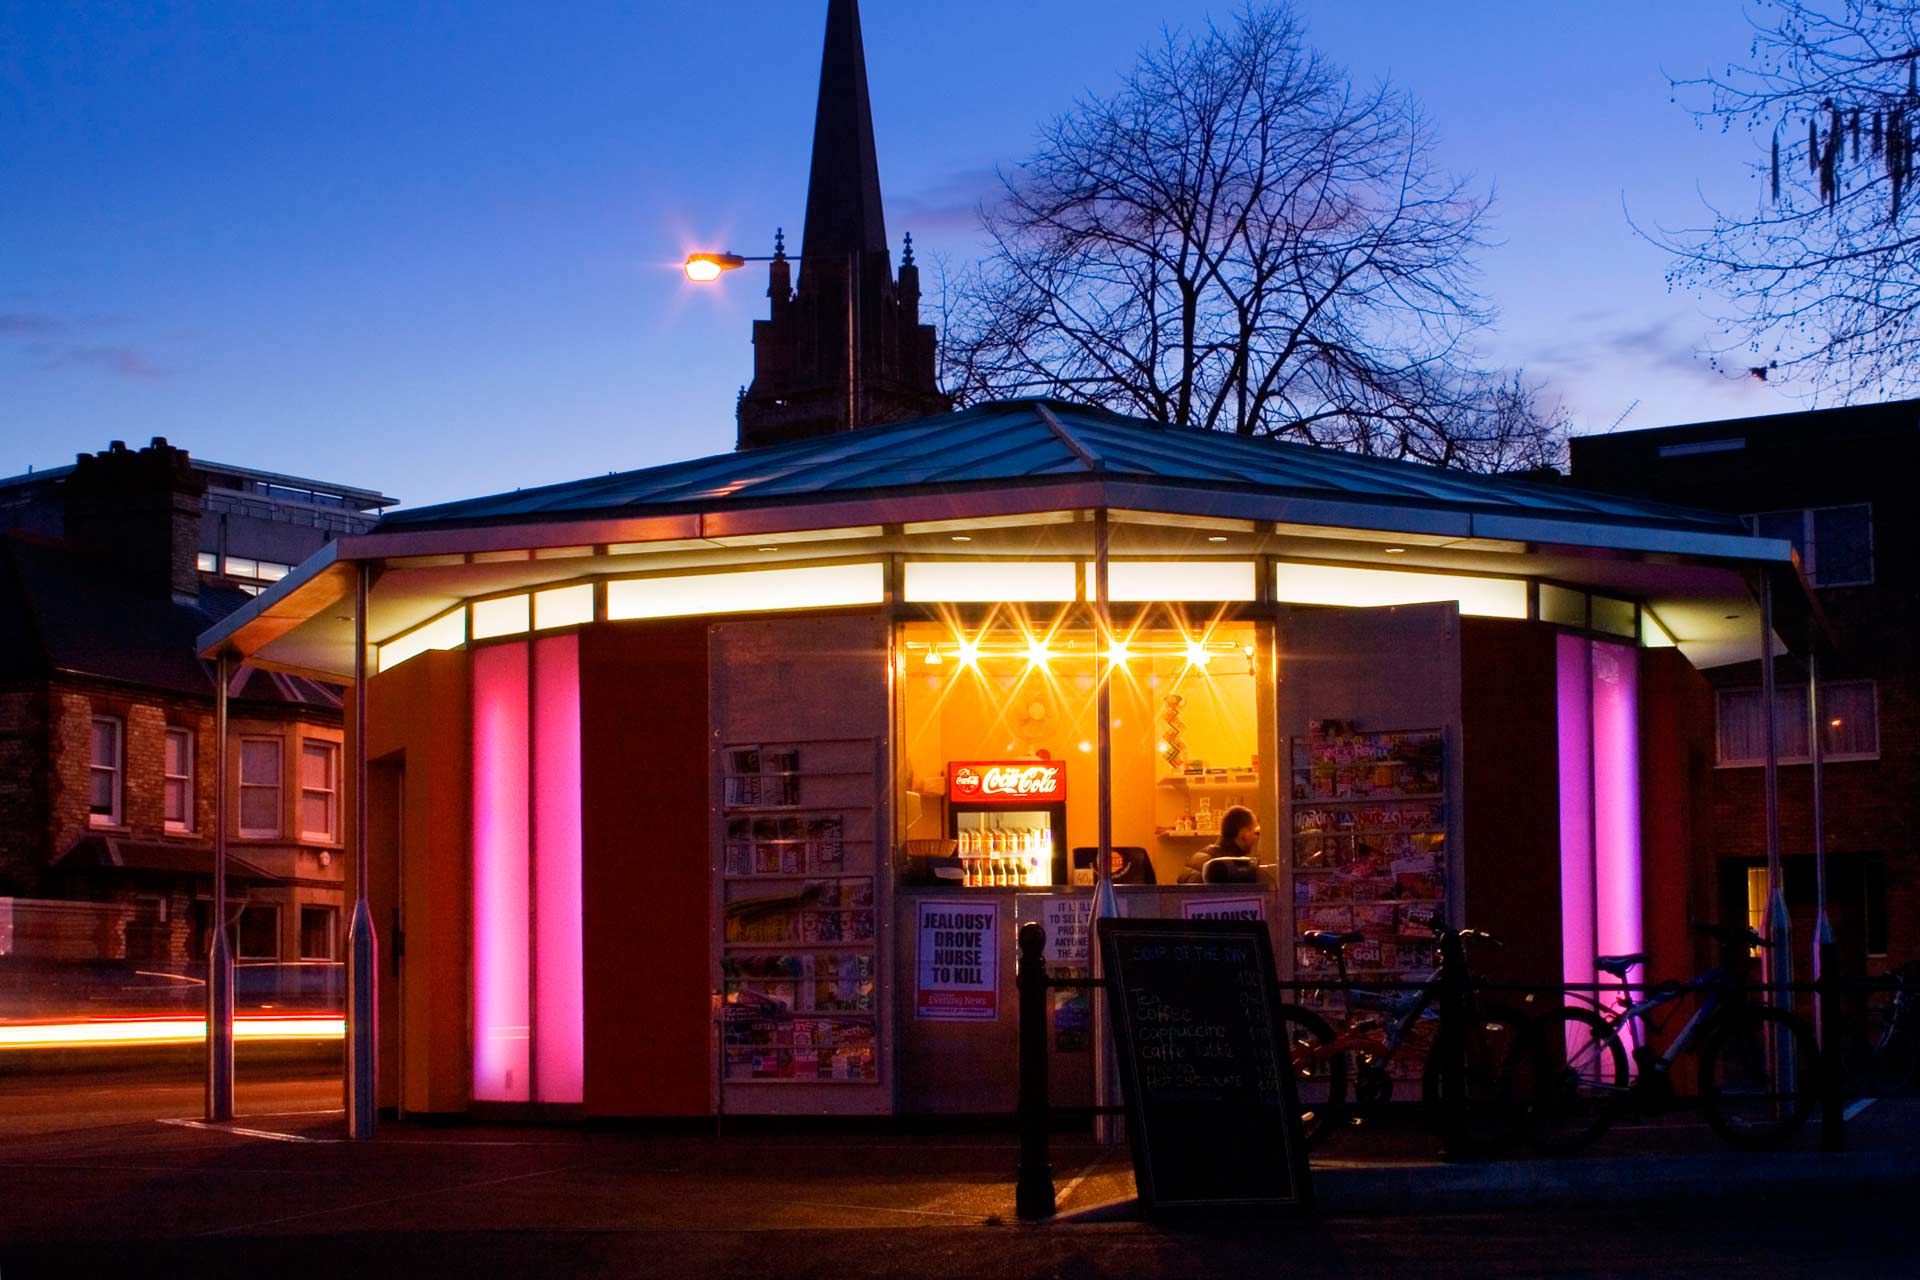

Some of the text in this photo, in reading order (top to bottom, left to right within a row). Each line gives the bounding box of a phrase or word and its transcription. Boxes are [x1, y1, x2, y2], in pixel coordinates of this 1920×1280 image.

[982, 767, 1059, 794] Coca-Cola
[1058, 902, 1065, 912] IT
[924, 913, 993, 930] JEALOUSY
[1050, 914, 1060, 924] TO
[1063, 914, 1082, 924] SELL
[1058, 926, 1088, 935] PRODU
[934, 931, 982, 948] DROVE
[934, 949, 982, 966] NURSE
[1057, 948, 1089, 958] THE AG
[932, 967, 983, 984] TO KILL
[964, 994, 987, 1006] News
